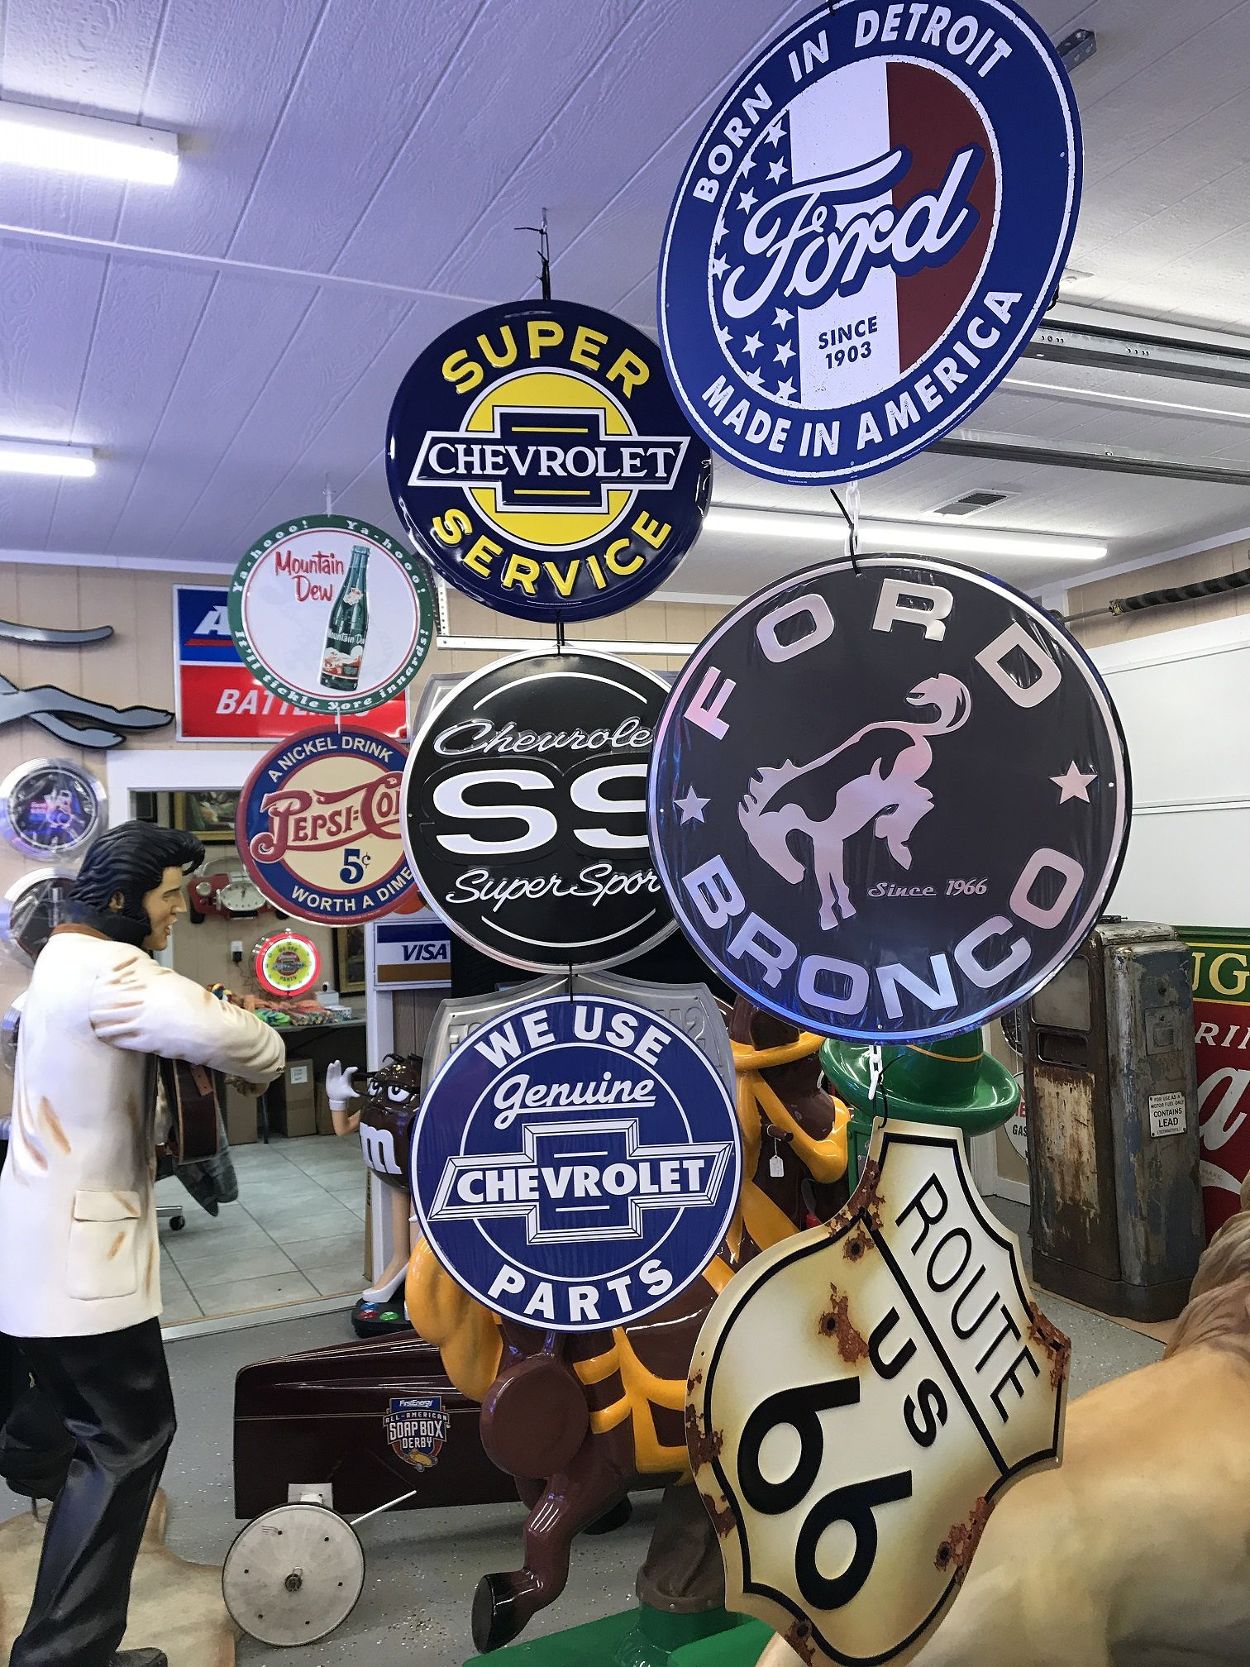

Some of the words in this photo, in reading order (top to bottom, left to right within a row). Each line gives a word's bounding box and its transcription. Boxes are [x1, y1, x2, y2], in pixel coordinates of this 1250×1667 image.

[693, 85, 773, 203] BORN
[787, 30, 829, 82] IN
[855, 3, 1012, 77] DETROIT
[723, 148, 974, 318] Ford
[818, 316, 878, 350] SINCE
[825, 341, 872, 369] 1903
[442, 321, 650, 399] SUPER
[702, 375, 792, 454] MADE
[799, 421, 840, 457] IN
[857, 291, 1022, 450] AMERICA
[428, 443, 675, 478] CHEVROLET
[275, 550, 344, 576] Mountain
[432, 508, 672, 596] SERVICE
[292, 575, 333, 602] Dew
[683, 578, 1062, 740] FORD
[262, 675, 319, 708] tickle
[433, 716, 653, 756] Chevrole
[267, 768, 281, 784] A
[277, 737, 338, 768] NICKEL
[342, 736, 393, 763] DRINK
[291, 886, 356, 912] WORTH
[362, 895, 375, 909] A
[376, 866, 414, 902] DIME
[446, 867, 572, 912] Super
[570, 863, 662, 907] Spor
[868, 878, 937, 898] Since
[945, 878, 988, 896] 1966
[402, 944, 447, 961] VISA
[682, 847, 1085, 1019] BRONCO
[474, 1010, 556, 1069] WE
[573, 1005, 672, 1066] USE
[1153, 1108, 1182, 1118] CONTAINS
[1158, 1117, 1179, 1128] LEAD
[360, 1122, 402, 1175] m
[457, 1159, 705, 1203] CHEVROLET
[487, 1259, 673, 1321] PARTS
[895, 1172, 1040, 1423] ROUTE
[867, 1307, 948, 1448] US
[389, 1421, 418, 1441] SOAP
[420, 1420, 444, 1439] BOX
[402, 1437, 433, 1449] DERBY
[737, 1375, 913, 1611] 66
